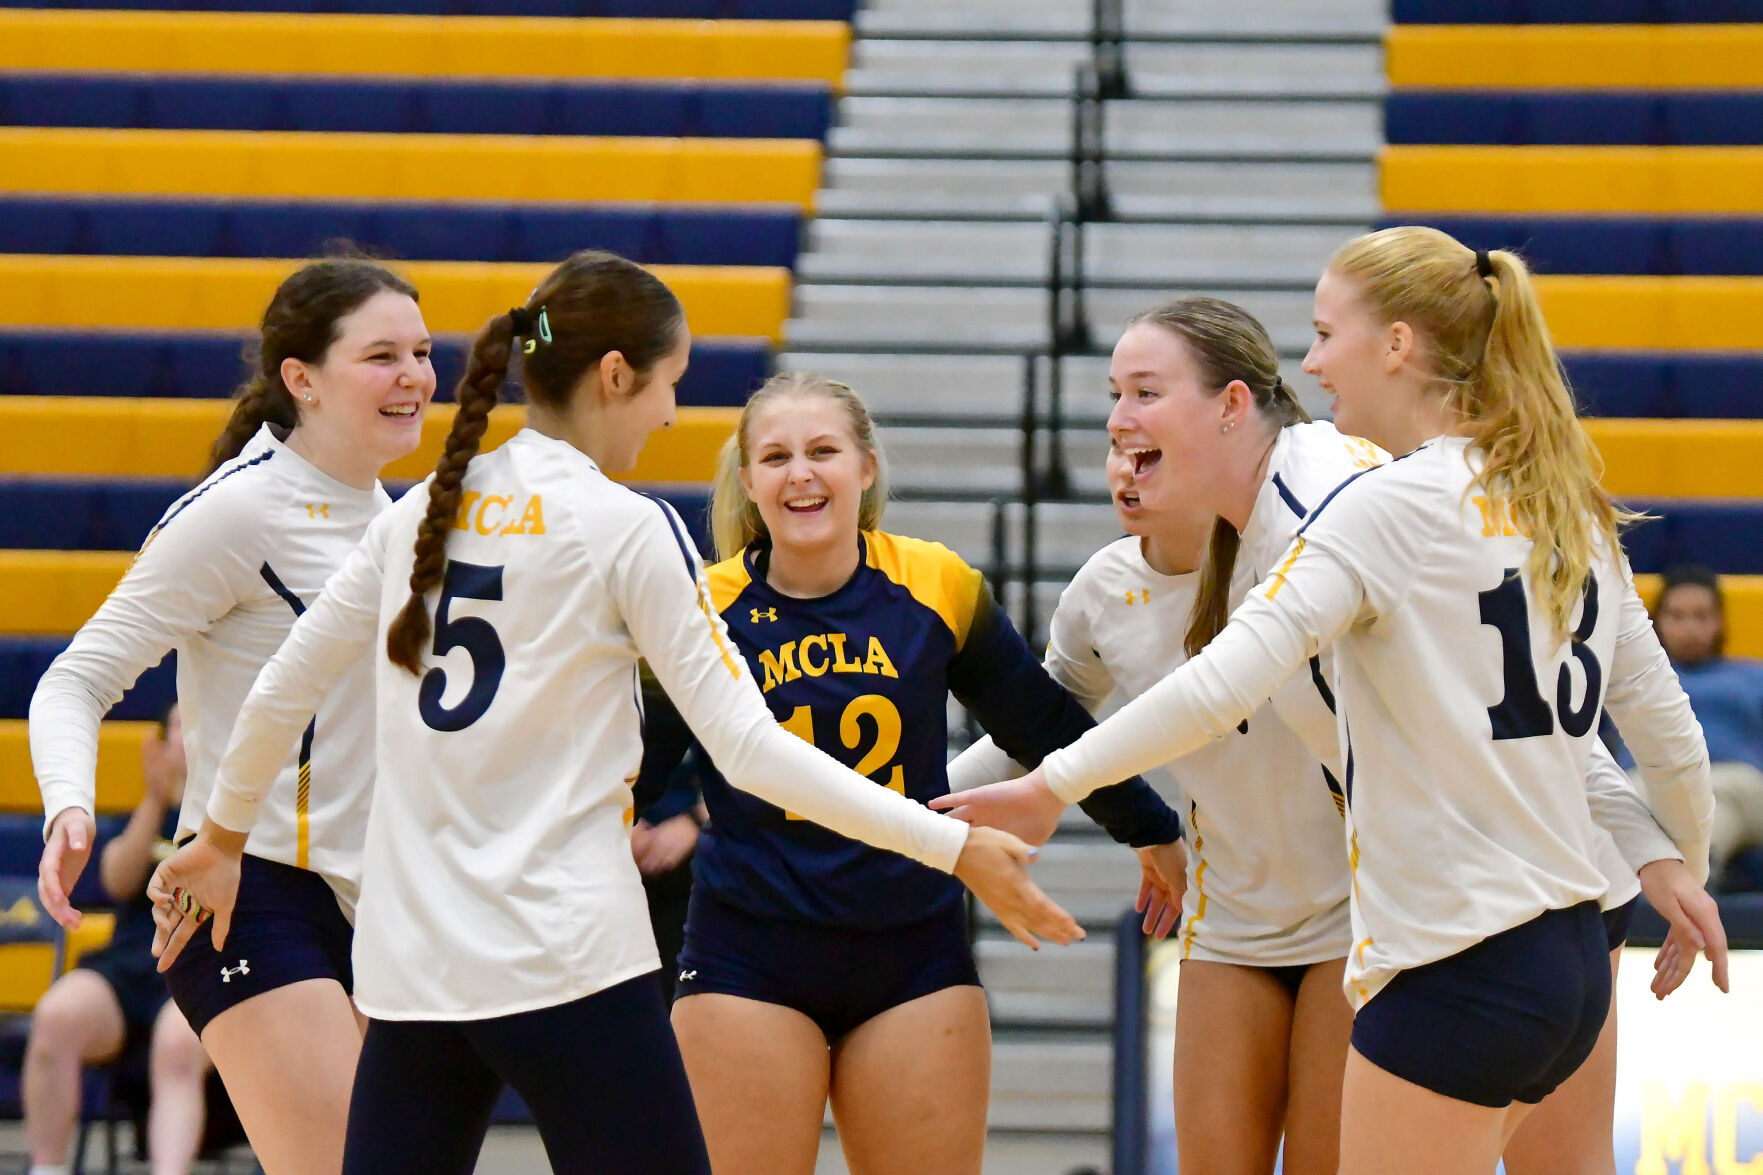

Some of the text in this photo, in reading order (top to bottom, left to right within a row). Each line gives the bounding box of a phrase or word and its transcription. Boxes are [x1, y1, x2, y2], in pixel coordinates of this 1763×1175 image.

[418, 559, 506, 733] 5
[758, 633, 899, 693] MCLA
[1478, 567, 1602, 740] 13
